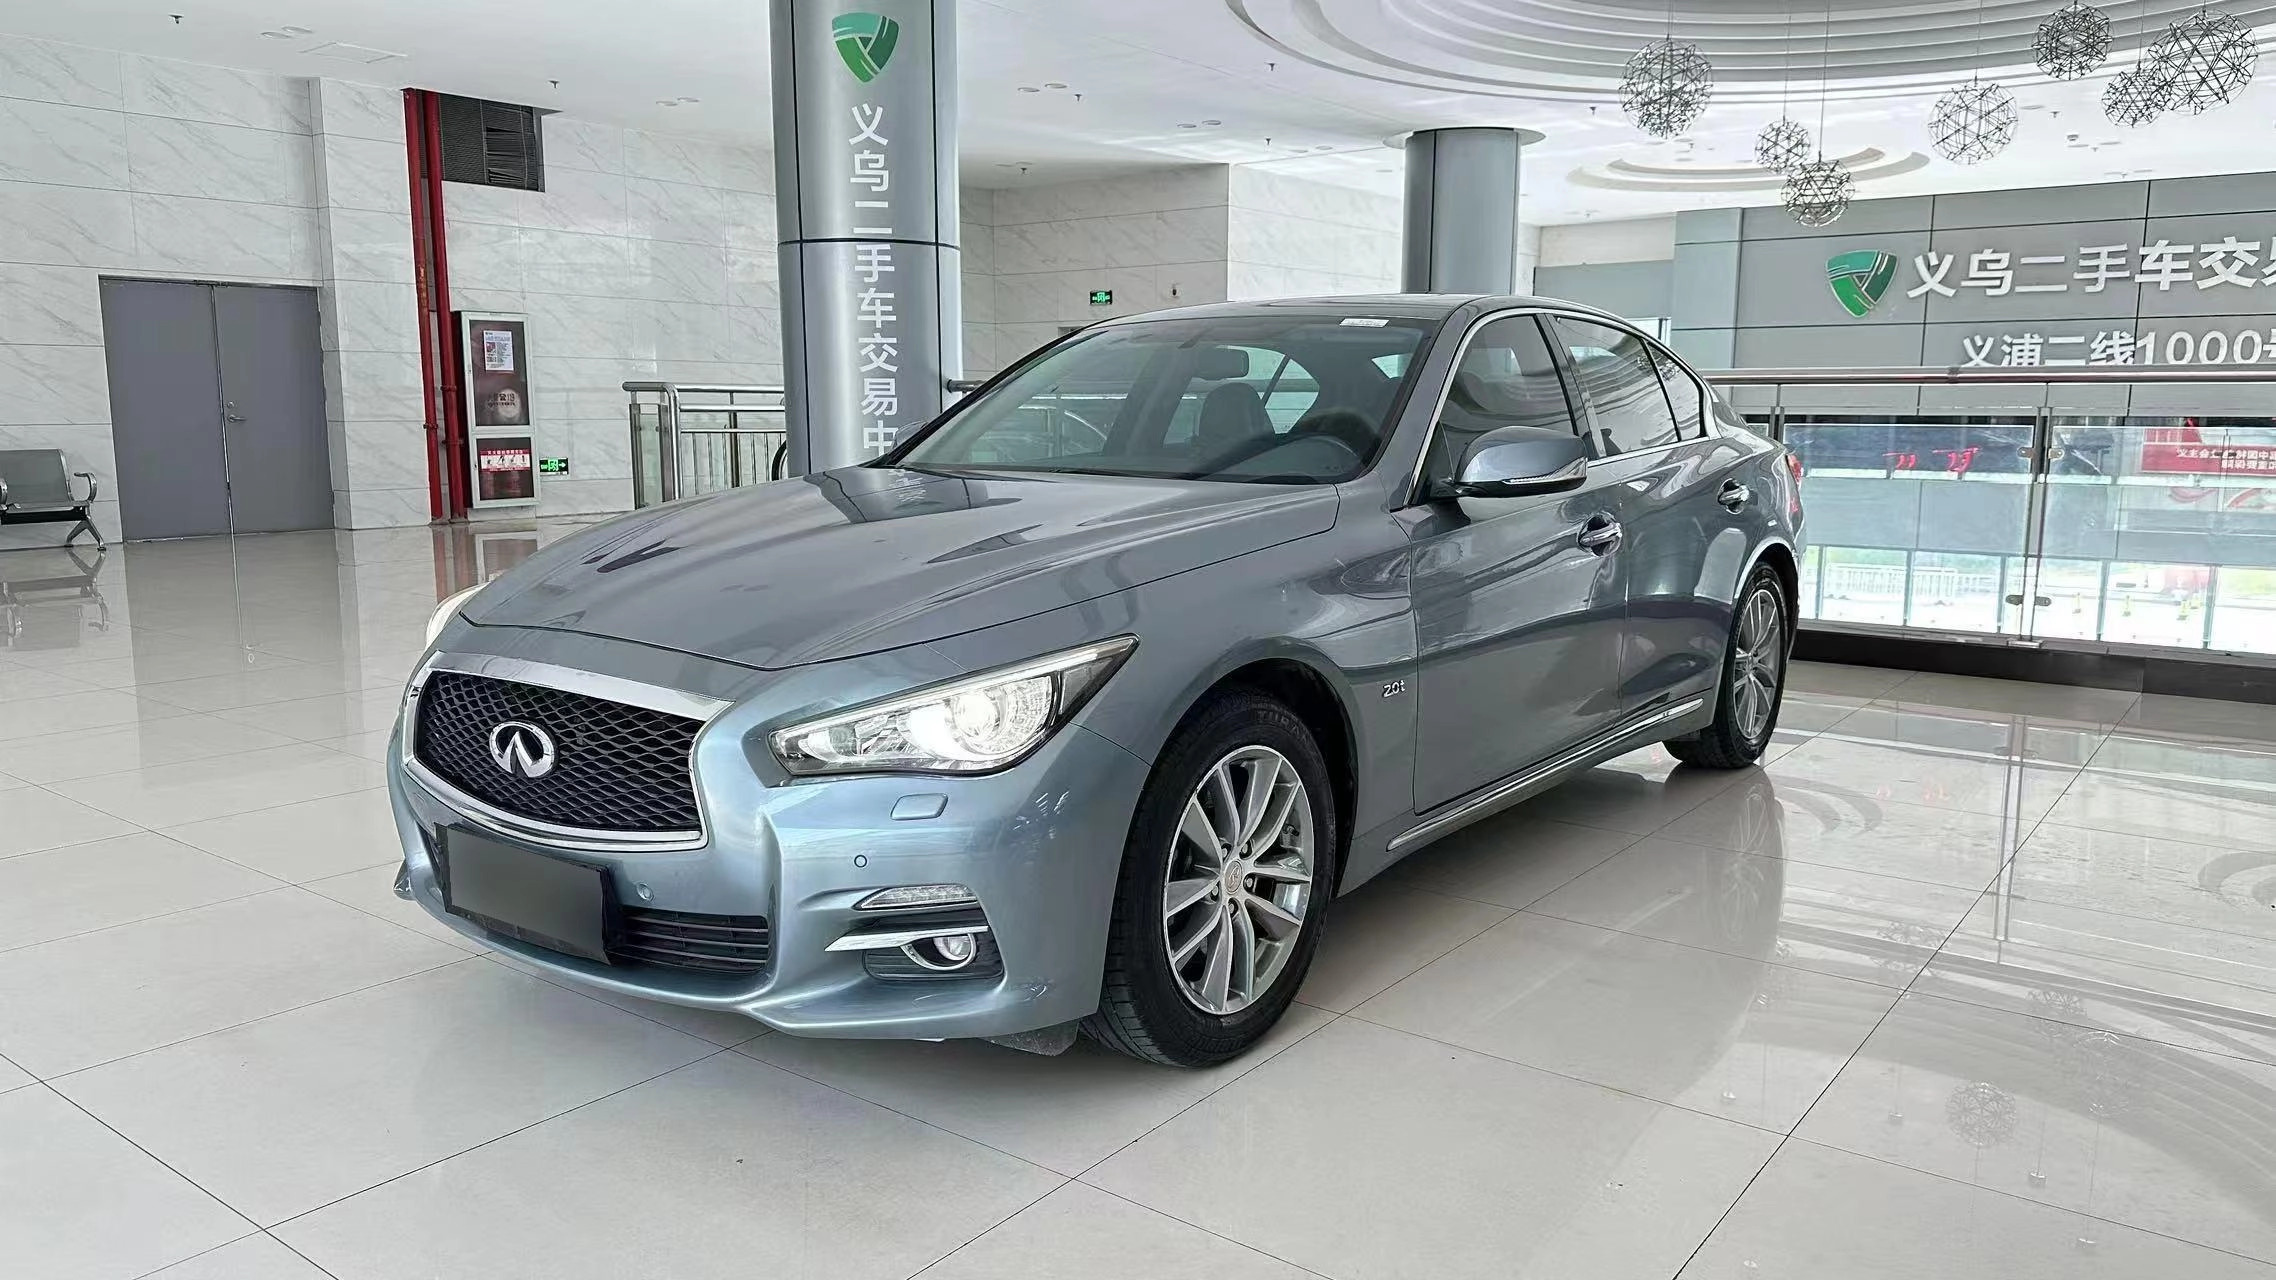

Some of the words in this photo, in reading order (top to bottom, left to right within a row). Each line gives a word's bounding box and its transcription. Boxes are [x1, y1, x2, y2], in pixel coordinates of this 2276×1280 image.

[848, 103, 899, 458] 义乌二手车交易中
[1907, 236, 2276, 298] 义乌二手车交
